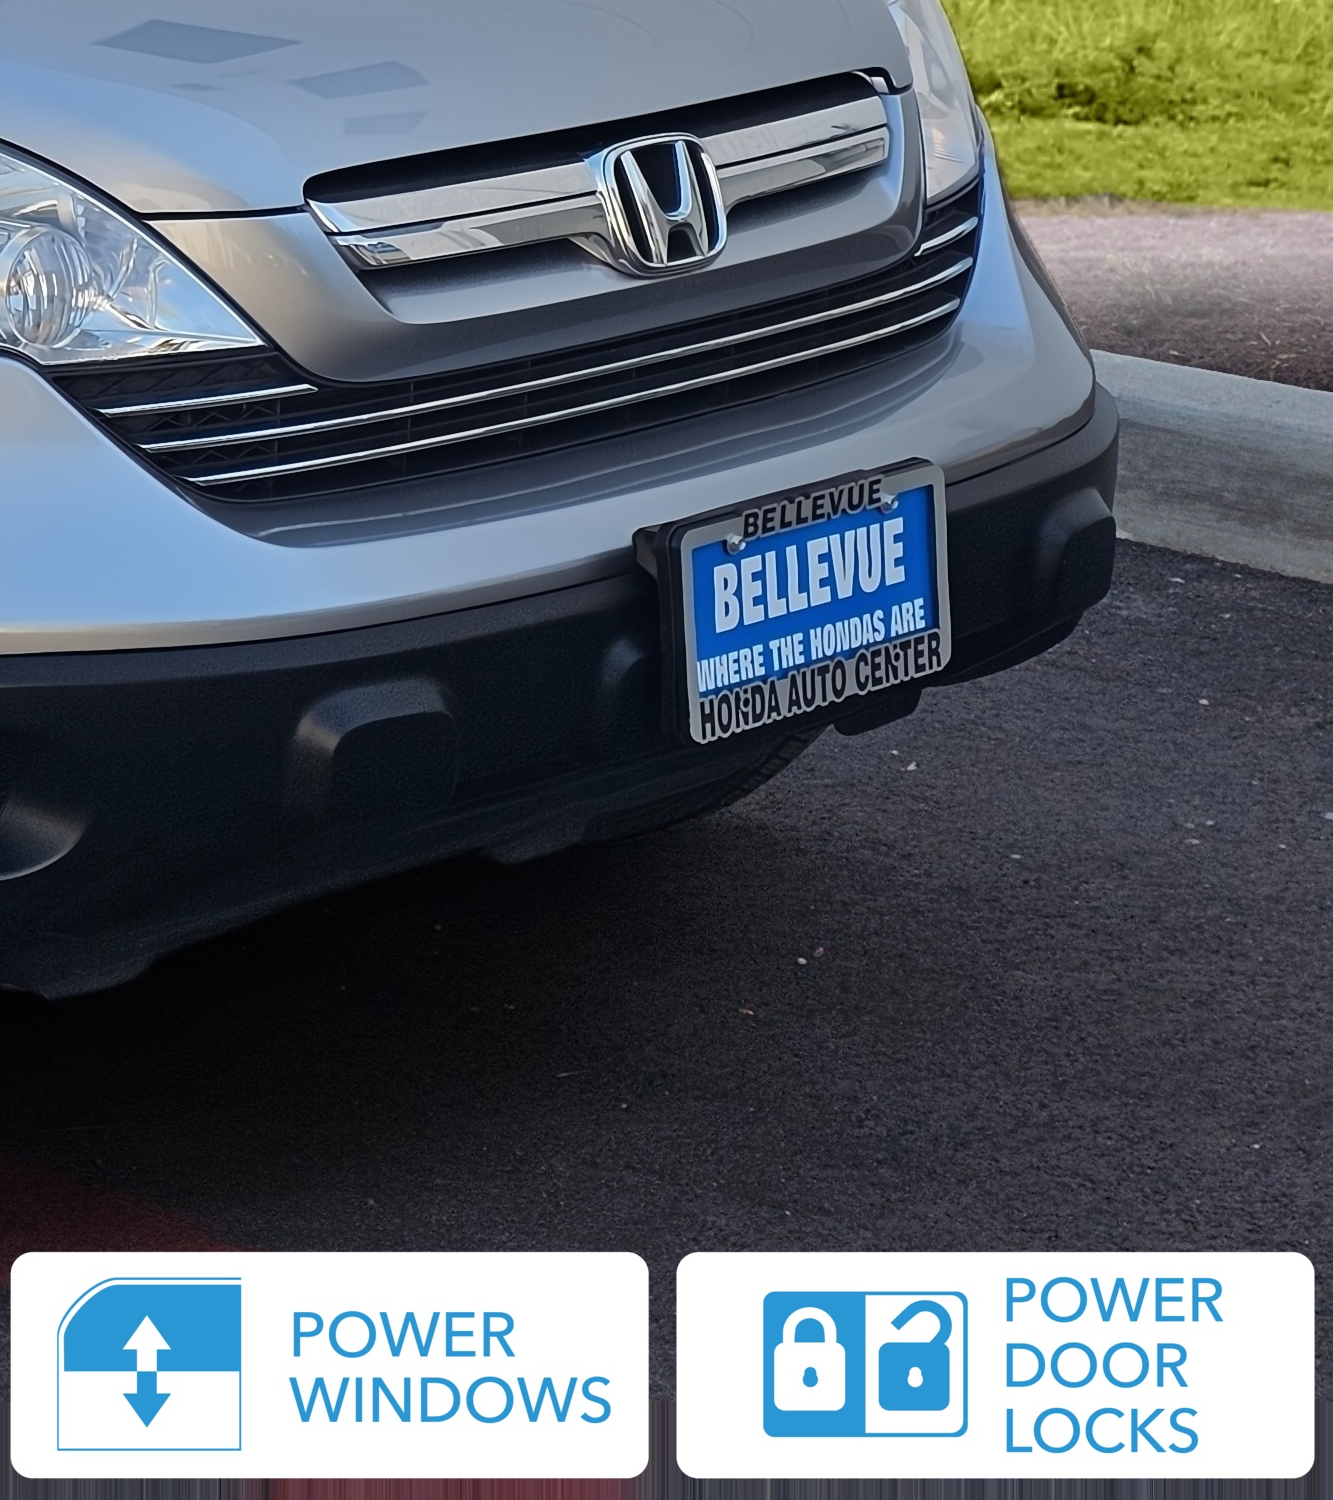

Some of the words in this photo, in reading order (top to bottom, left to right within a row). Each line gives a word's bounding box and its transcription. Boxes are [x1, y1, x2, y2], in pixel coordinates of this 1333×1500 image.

[743, 478, 884, 537] BELLEVUE
[713, 516, 906, 634] BELLEVUE
[696, 649, 766, 693] WHERE
[769, 634, 805, 669] THE
[809, 614, 886, 661] HONDAS
[890, 597, 927, 634] ARE
[699, 688, 782, 741] HONDA
[787, 661, 846, 718] AUTO
[854, 632, 943, 697] CENTER
